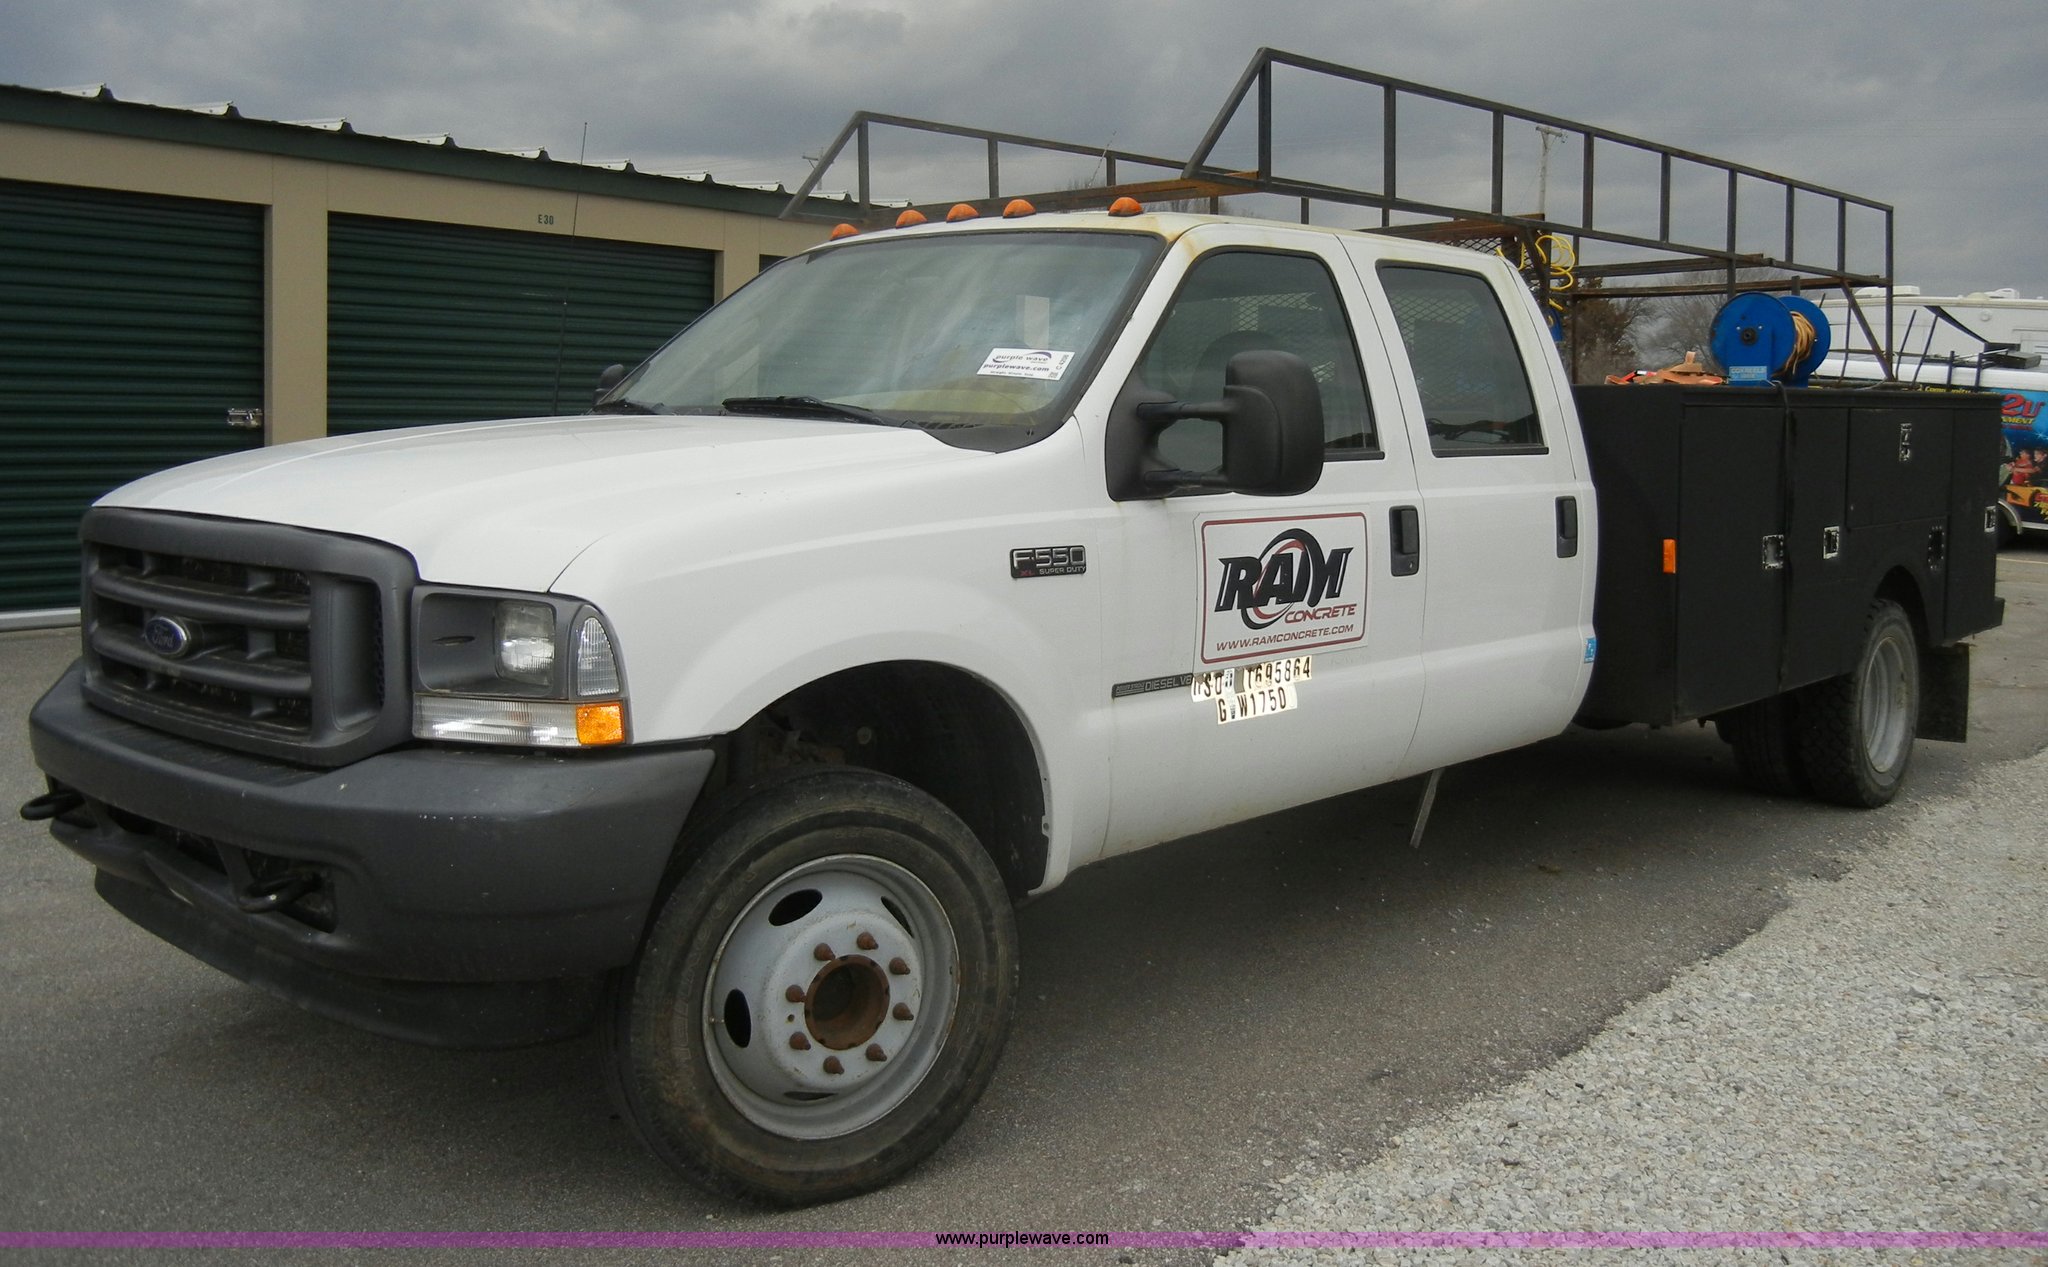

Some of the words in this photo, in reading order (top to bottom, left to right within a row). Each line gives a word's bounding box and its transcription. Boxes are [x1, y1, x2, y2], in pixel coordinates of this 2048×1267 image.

[983, 363, 1050, 372] purplewave.com
[1012, 546, 1086, 569] F-550
[1039, 567, 1065, 575] SUPER
[1214, 530, 1354, 613] RAM
[1284, 603, 1357, 624] CONCRETE
[1216, 624, 1354, 651] WWW.RAMCONCRETE.COM
[1144, 676, 1180, 691] DIESEL
[1180, 674, 1193, 686] V8
